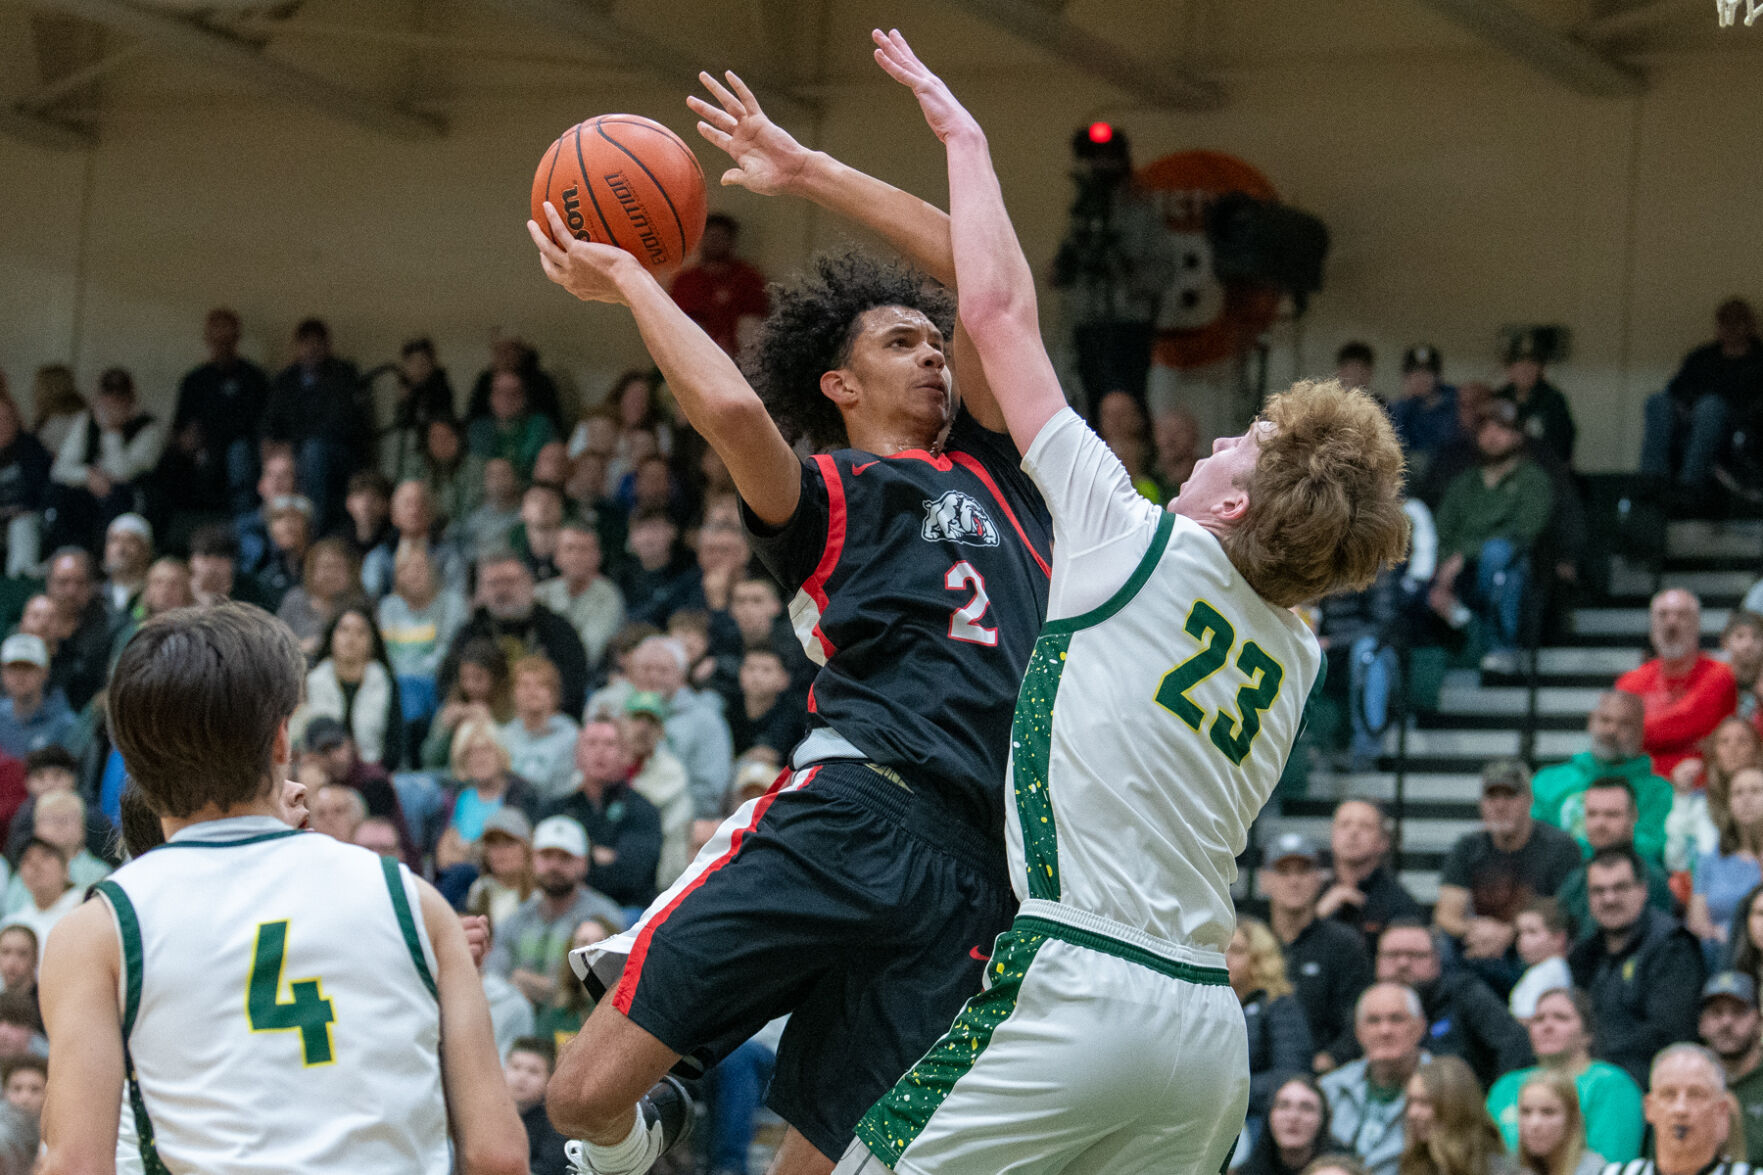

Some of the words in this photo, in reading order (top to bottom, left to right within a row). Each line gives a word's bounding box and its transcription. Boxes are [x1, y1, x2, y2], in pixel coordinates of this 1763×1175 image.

[604, 174, 667, 265] EVOLUTION
[945, 560, 998, 646] 2
[1153, 598, 1285, 768] 23
[244, 918, 338, 1068] 4
